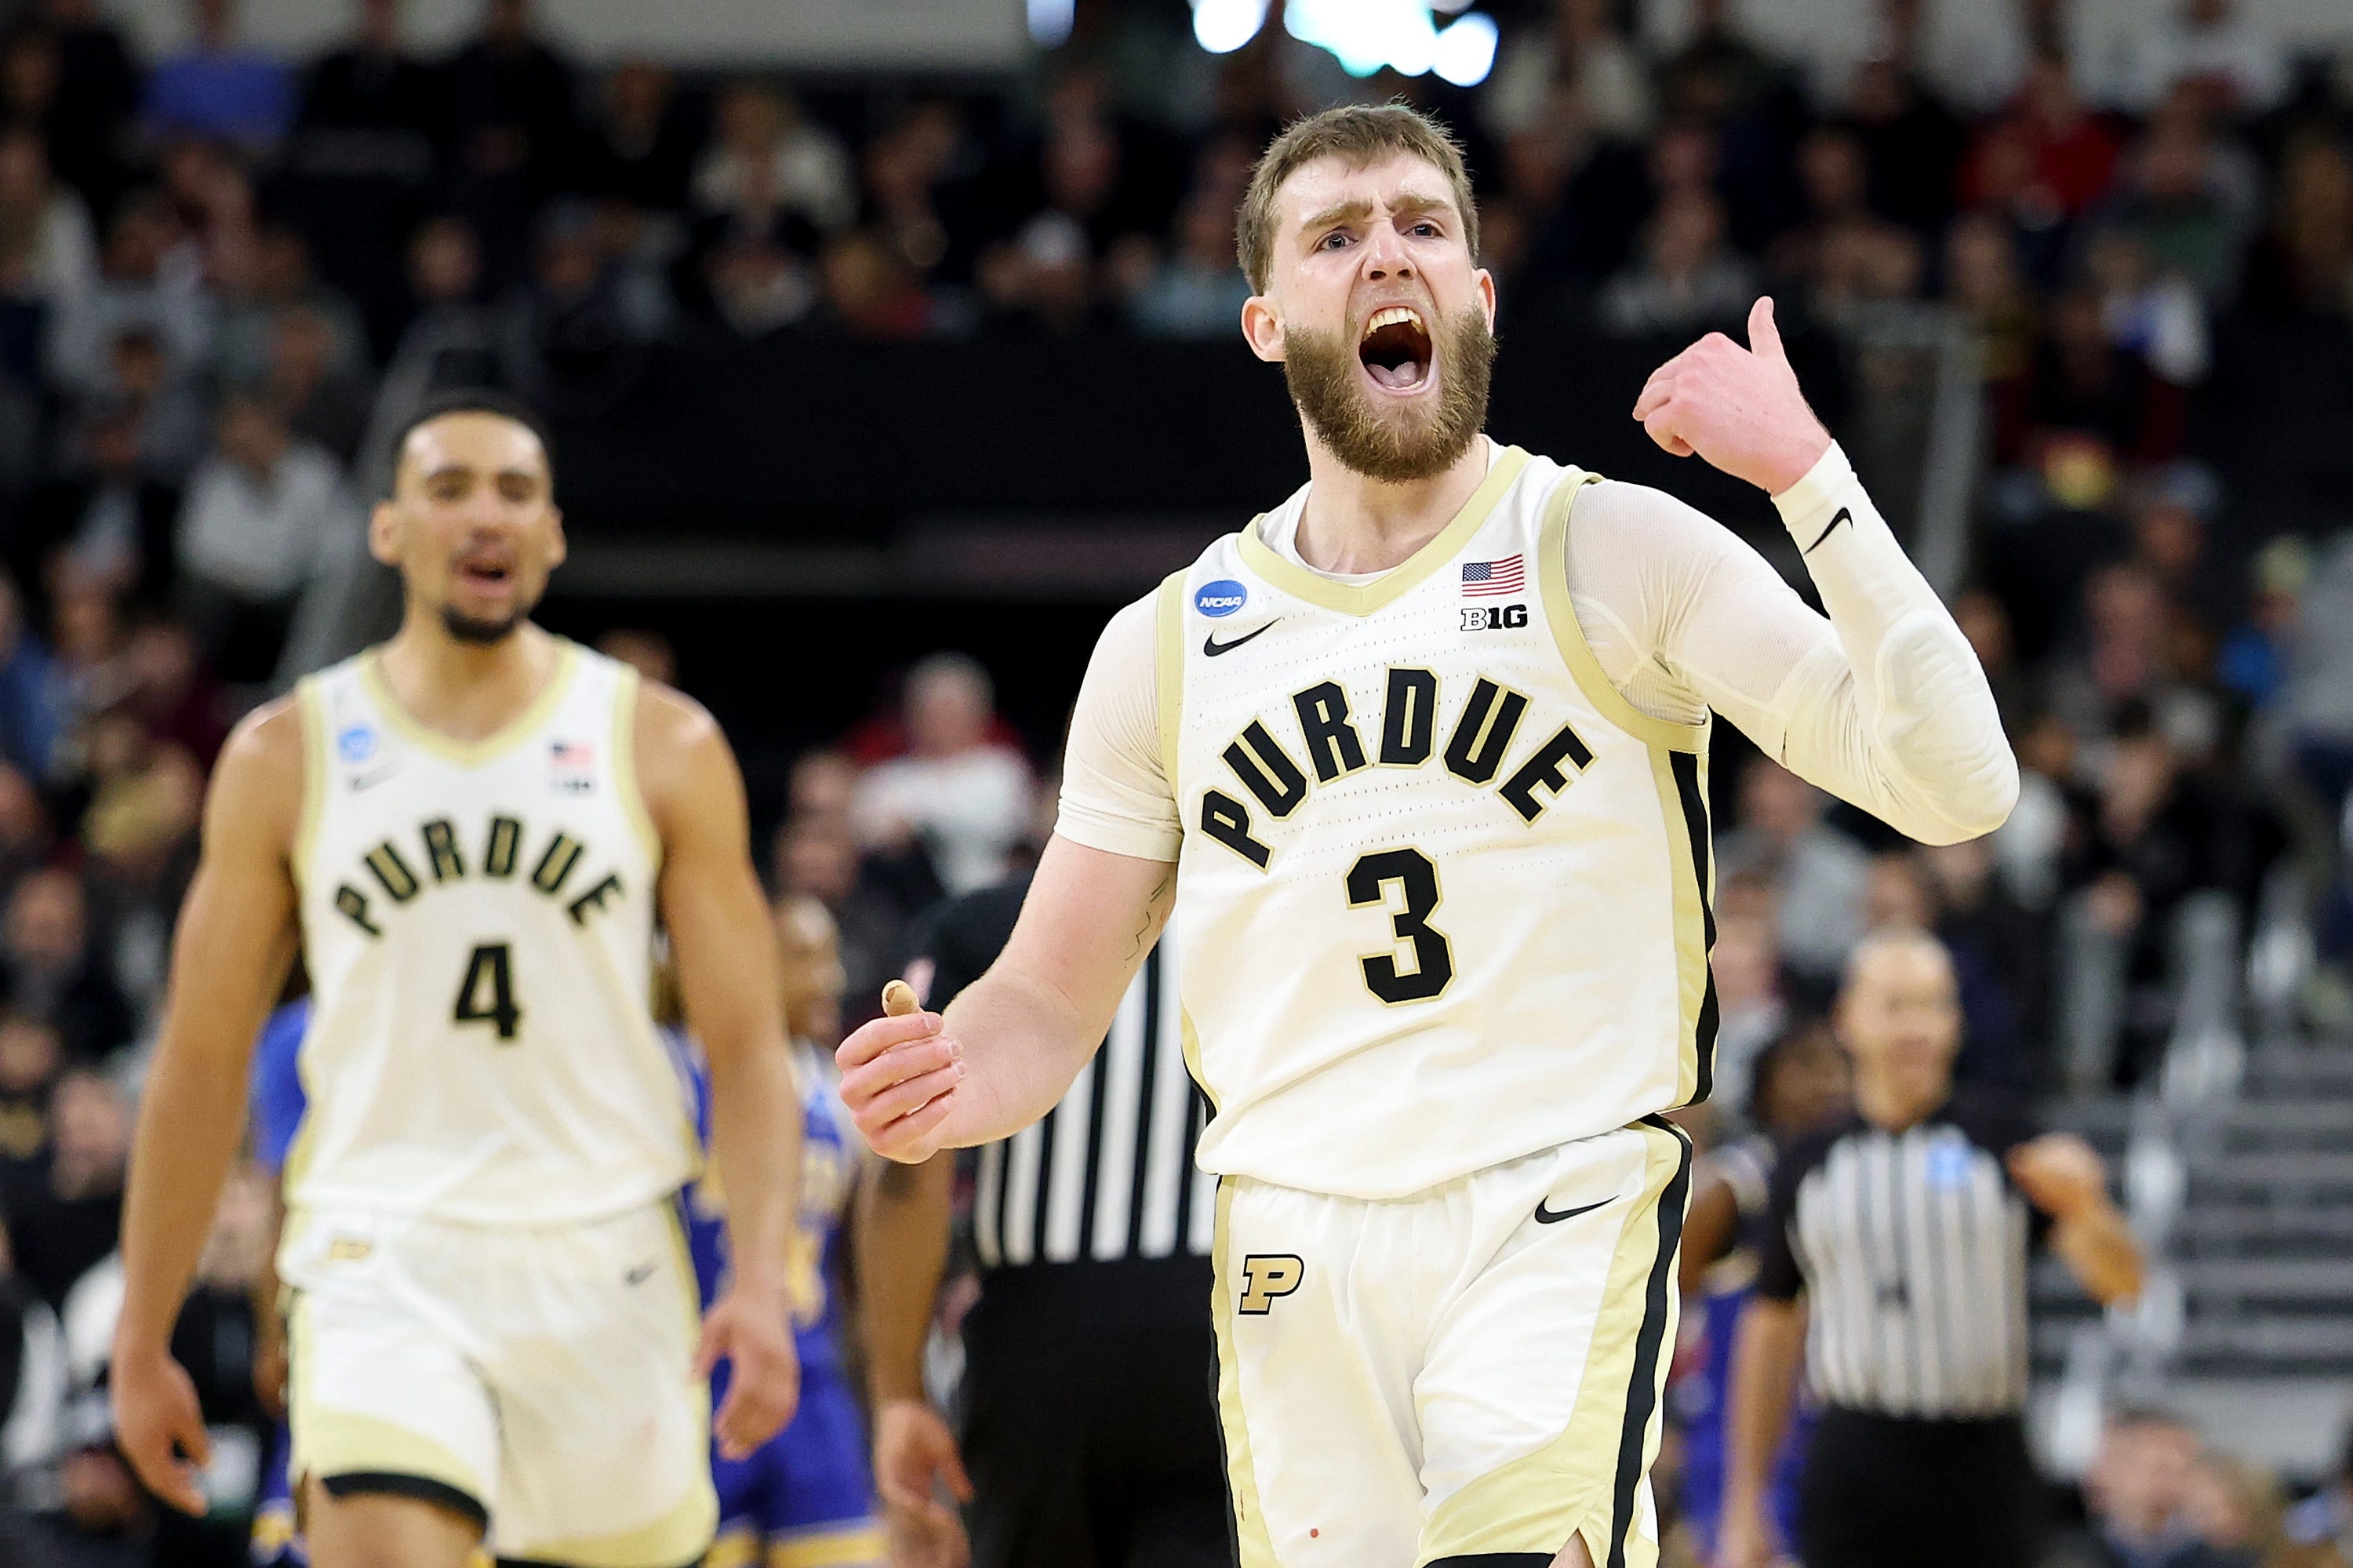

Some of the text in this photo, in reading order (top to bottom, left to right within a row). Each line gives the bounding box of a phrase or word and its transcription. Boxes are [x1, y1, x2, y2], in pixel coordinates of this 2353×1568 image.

[1199, 596, 1242, 608] NCAA
[1199, 665, 1599, 874] PURDUE
[335, 815, 624, 937] PURDUE
[1344, 845, 1457, 1007] 3
[454, 944, 522, 1038] 4
[1238, 1253, 1304, 1315] P
